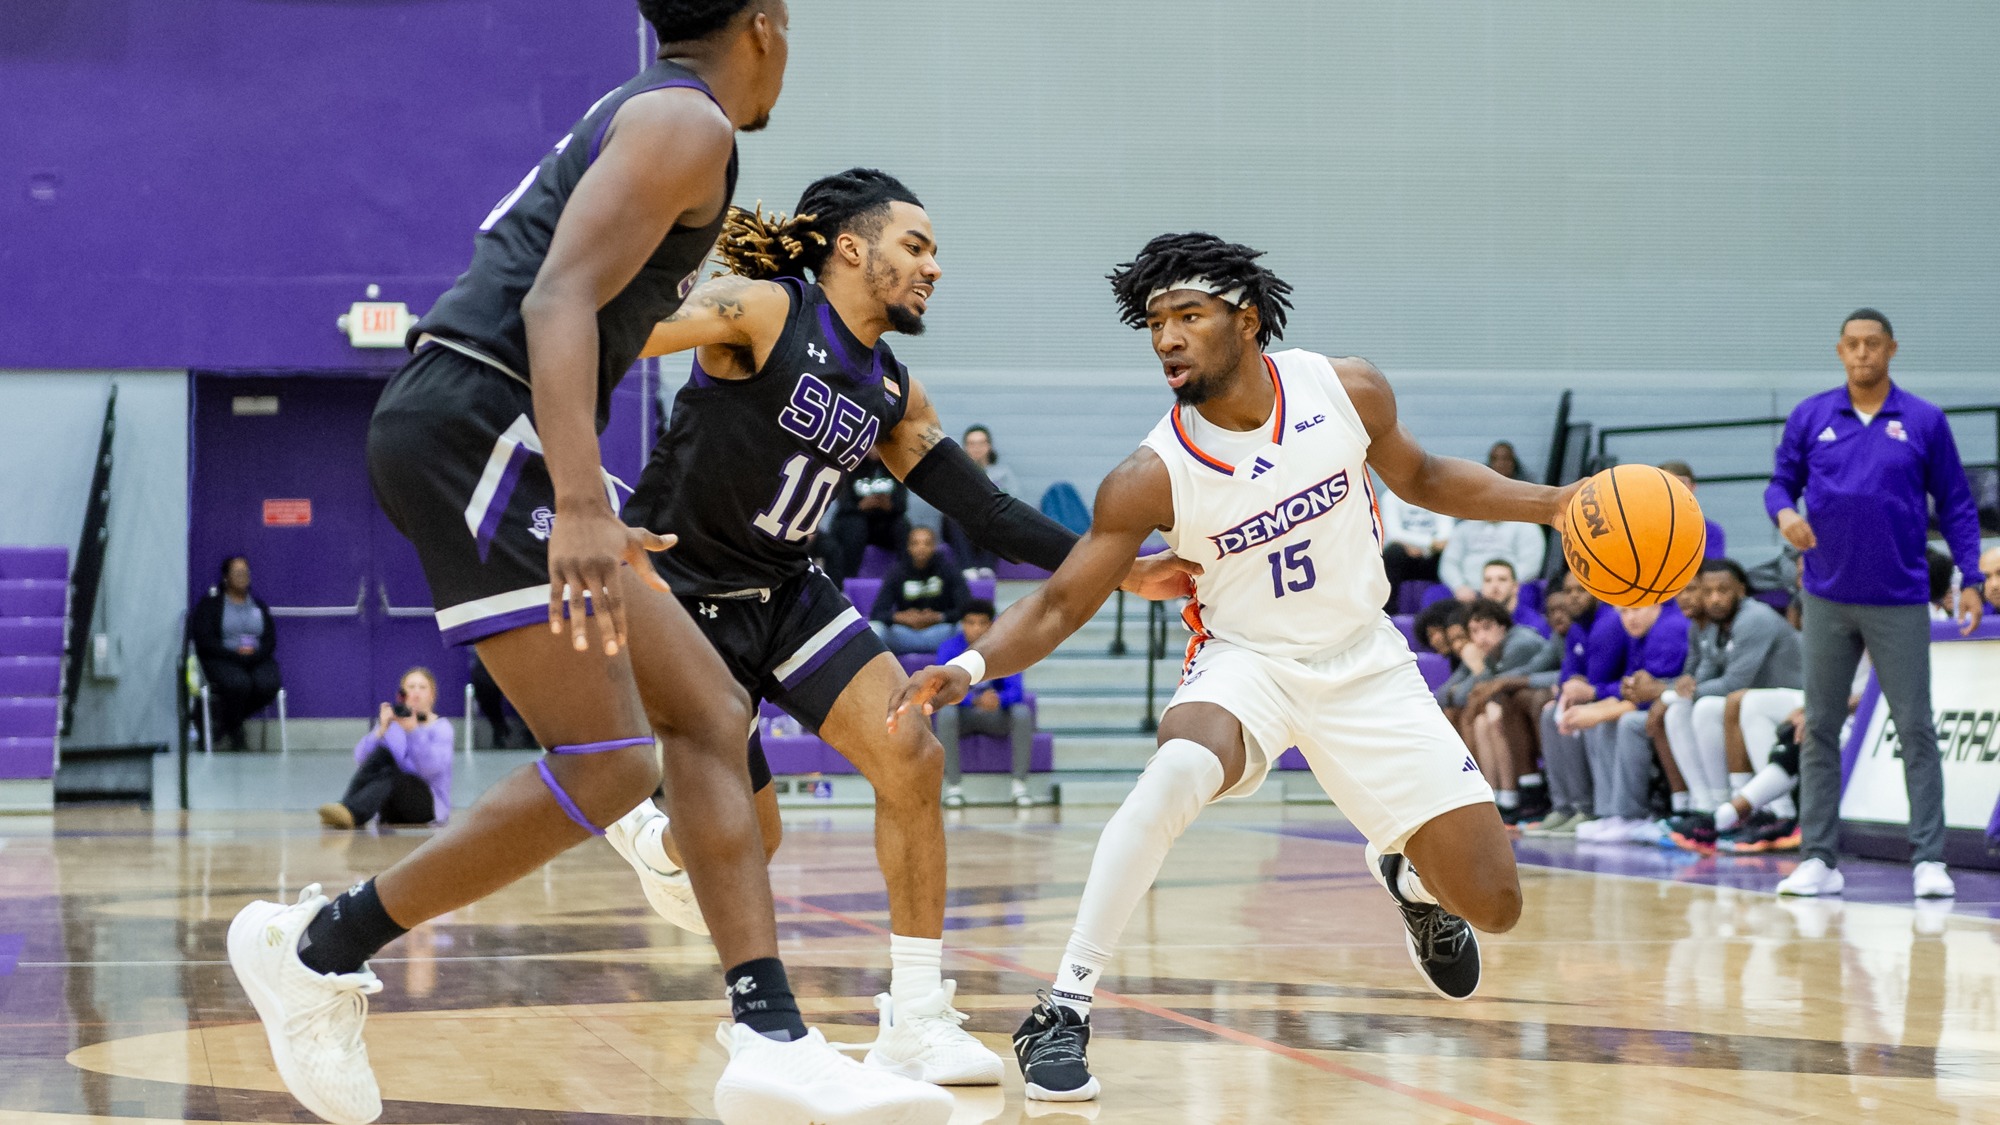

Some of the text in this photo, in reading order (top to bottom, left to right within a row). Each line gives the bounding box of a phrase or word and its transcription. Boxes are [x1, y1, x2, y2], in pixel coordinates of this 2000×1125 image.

[363, 306, 396, 331] EXIT
[778, 372, 880, 472] SFA
[1294, 414, 1325, 433] SLC
[752, 453, 842, 541] 10
[1217, 474, 1348, 556] DEMONS
[1268, 539, 1316, 598] 15
